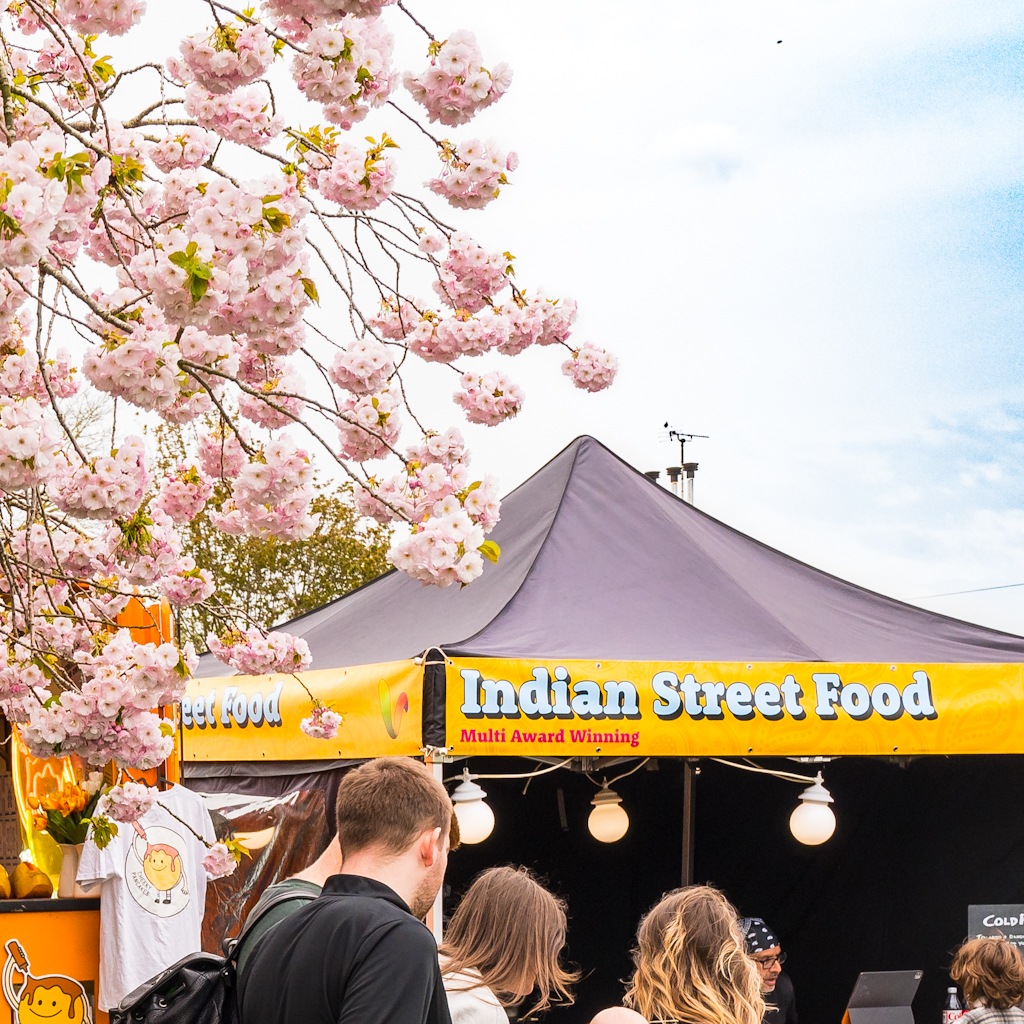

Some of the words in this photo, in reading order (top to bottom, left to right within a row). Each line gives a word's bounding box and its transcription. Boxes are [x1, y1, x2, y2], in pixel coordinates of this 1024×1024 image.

[180, 688, 217, 730] eet
[220, 680, 284, 729] Food
[460, 666, 642, 719] Indian
[652, 671, 807, 721] Street
[812, 670, 937, 721] Food
[460, 728, 506, 744] Multi
[510, 729, 566, 744] Award
[569, 729, 640, 747] Winning
